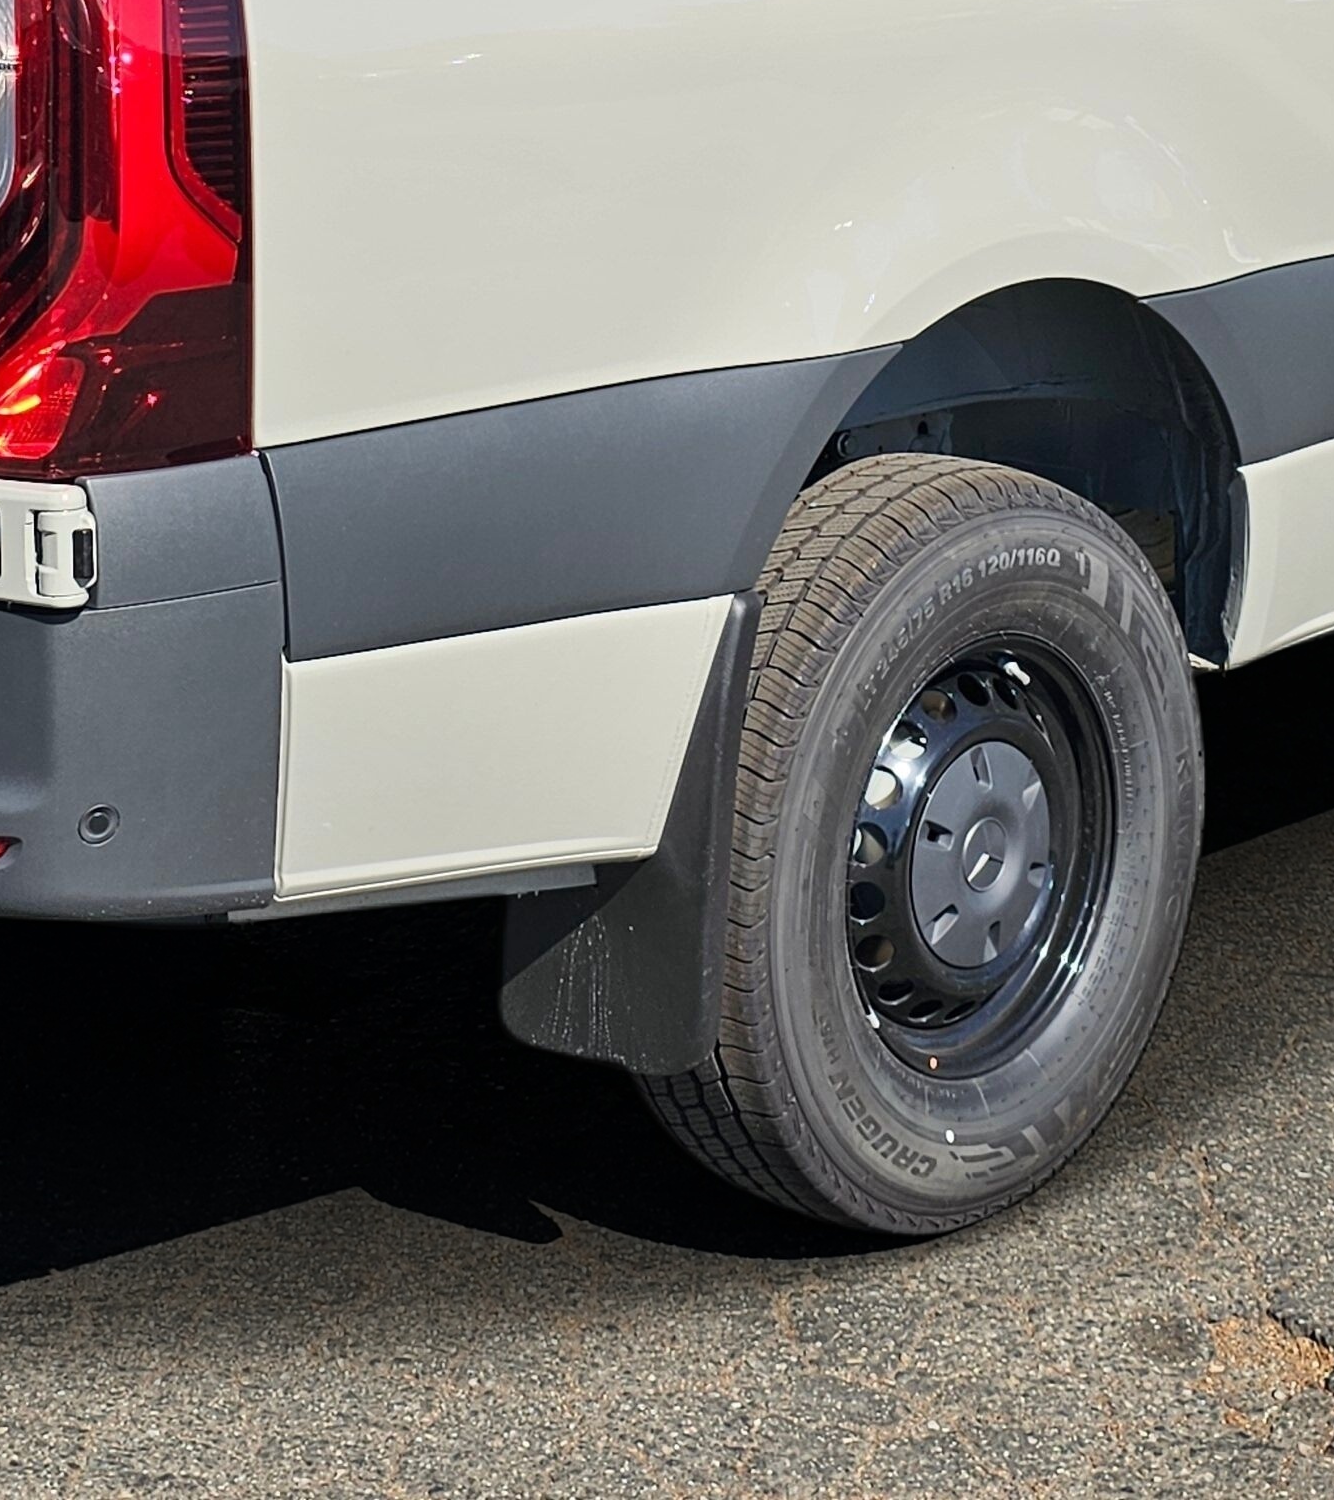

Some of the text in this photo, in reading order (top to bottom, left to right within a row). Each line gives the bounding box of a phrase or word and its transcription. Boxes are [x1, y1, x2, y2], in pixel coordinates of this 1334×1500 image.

[877, 596, 935, 680] 245/75
[938, 568, 974, 605] R16
[978, 546, 1061, 579] 120/116Q
[828, 1073, 938, 1179] CRUGEN
